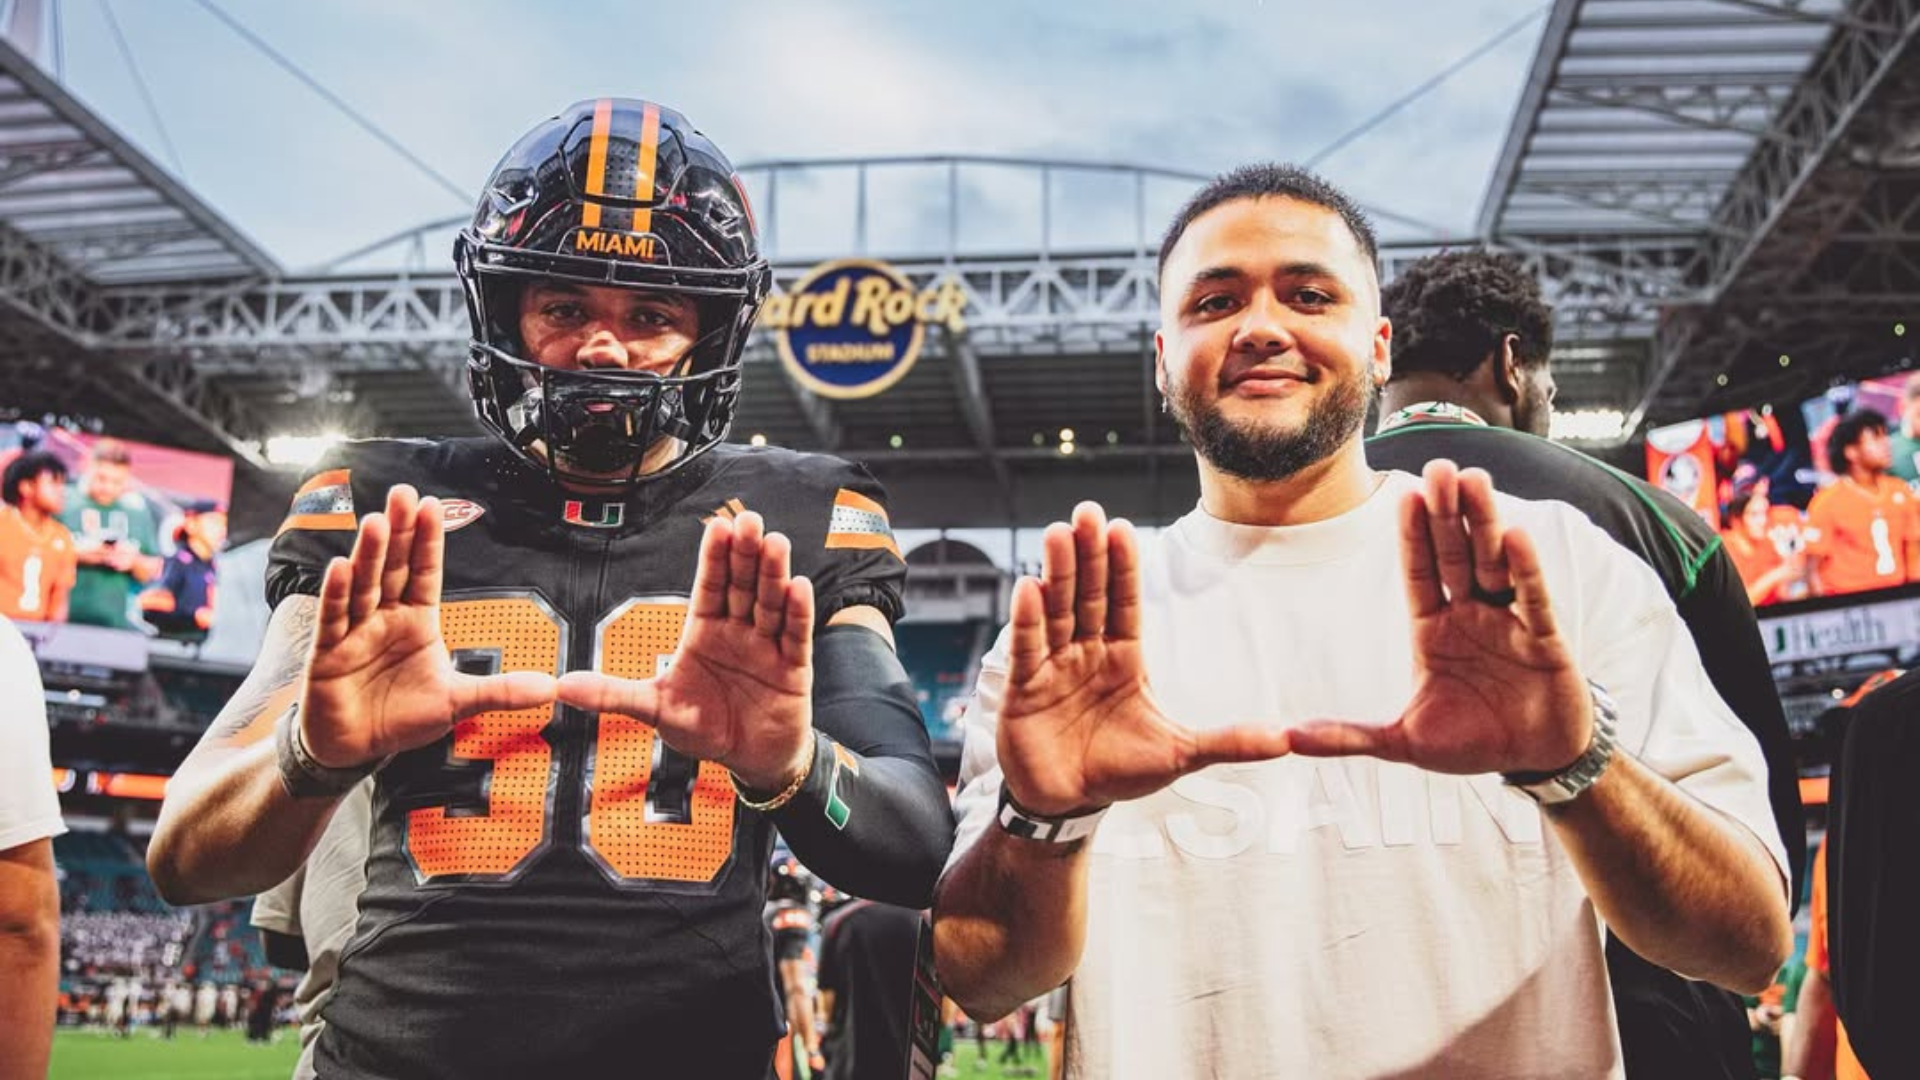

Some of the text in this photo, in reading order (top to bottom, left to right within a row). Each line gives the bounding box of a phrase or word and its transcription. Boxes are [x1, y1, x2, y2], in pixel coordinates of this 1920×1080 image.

[576, 230, 655, 258] MIAMI
[757, 274, 967, 335] ard Rock
[402, 588, 738, 890] 30
